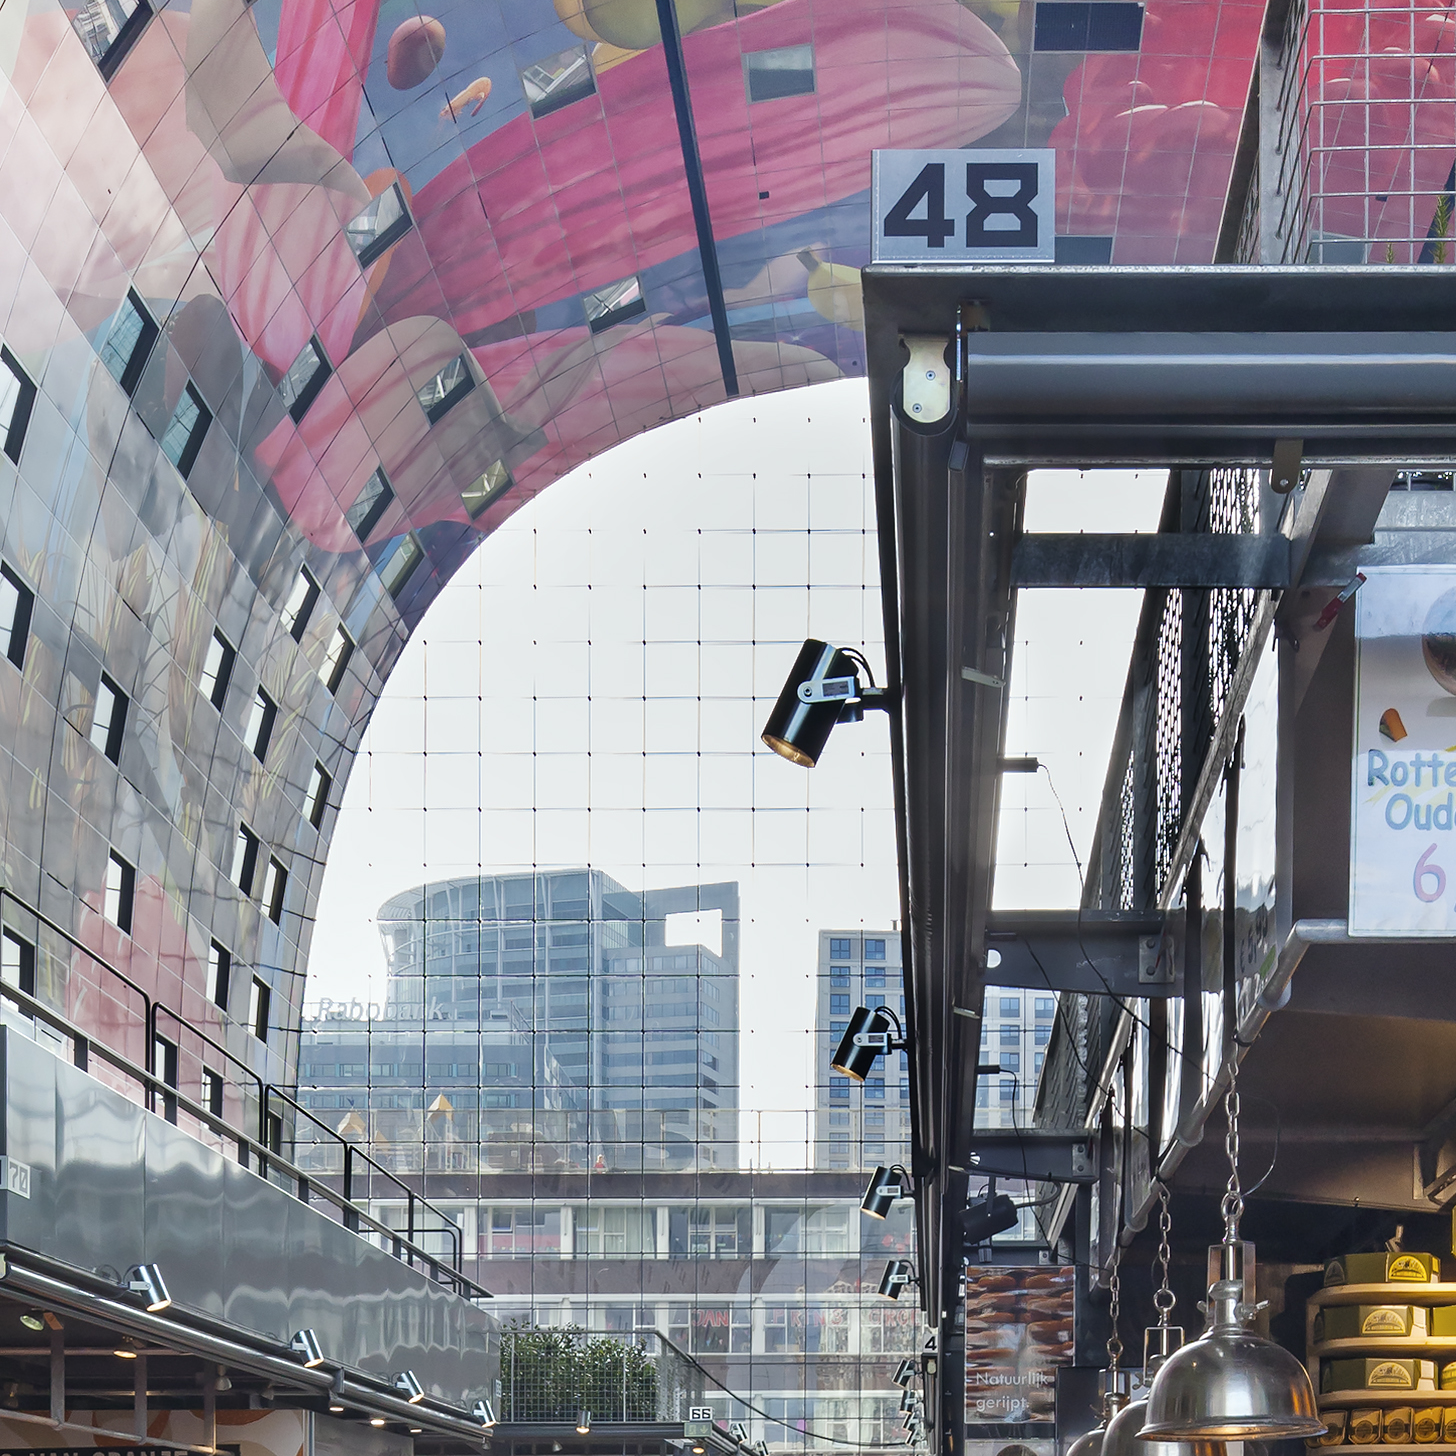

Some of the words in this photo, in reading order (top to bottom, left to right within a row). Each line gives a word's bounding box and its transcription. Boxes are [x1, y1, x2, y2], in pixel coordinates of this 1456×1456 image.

[884, 162, 1039, 248] 48
[316, 996, 445, 1021] Rabobank
[976, 1372, 1048, 1388] Natuurlijk
[976, 1396, 1029, 1412] gerijpt.
